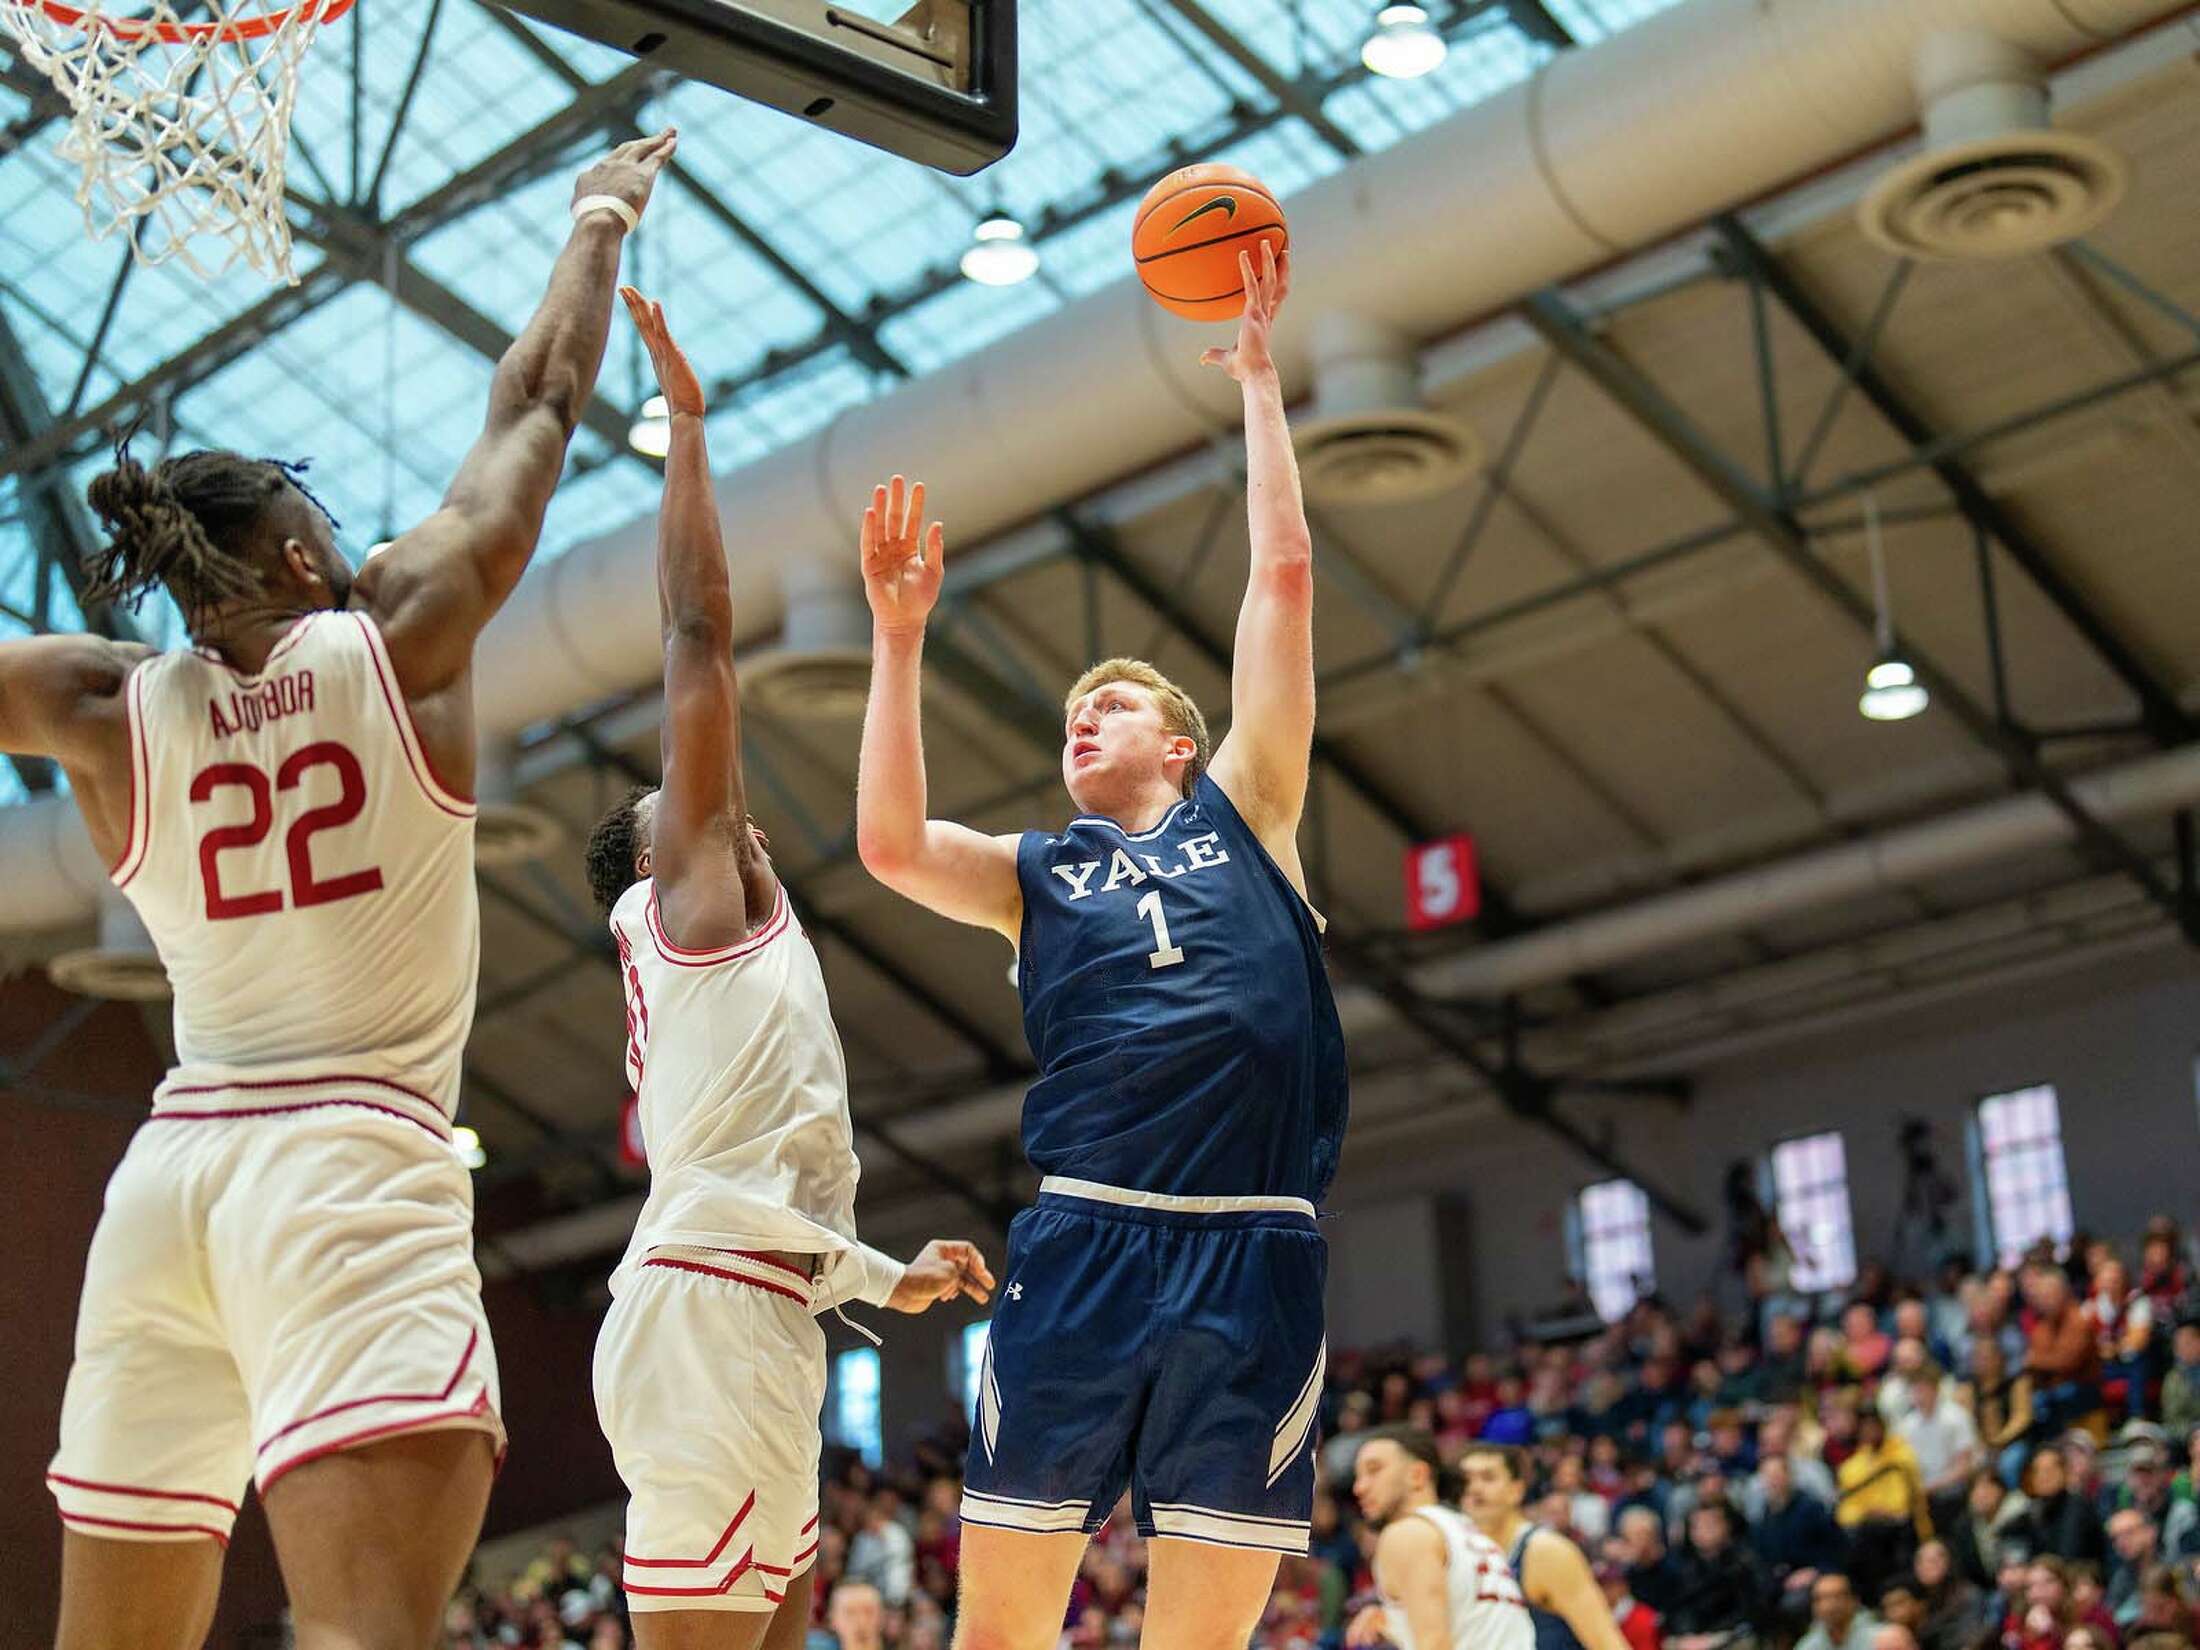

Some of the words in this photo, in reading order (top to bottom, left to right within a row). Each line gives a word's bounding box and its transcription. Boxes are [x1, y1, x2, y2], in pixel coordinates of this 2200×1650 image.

[210, 669, 314, 739] AJOBOR
[189, 741, 383, 920] 22
[1051, 831, 1230, 901] YALE
[1418, 846, 1459, 917] 5
[1136, 890, 1185, 969] 1
